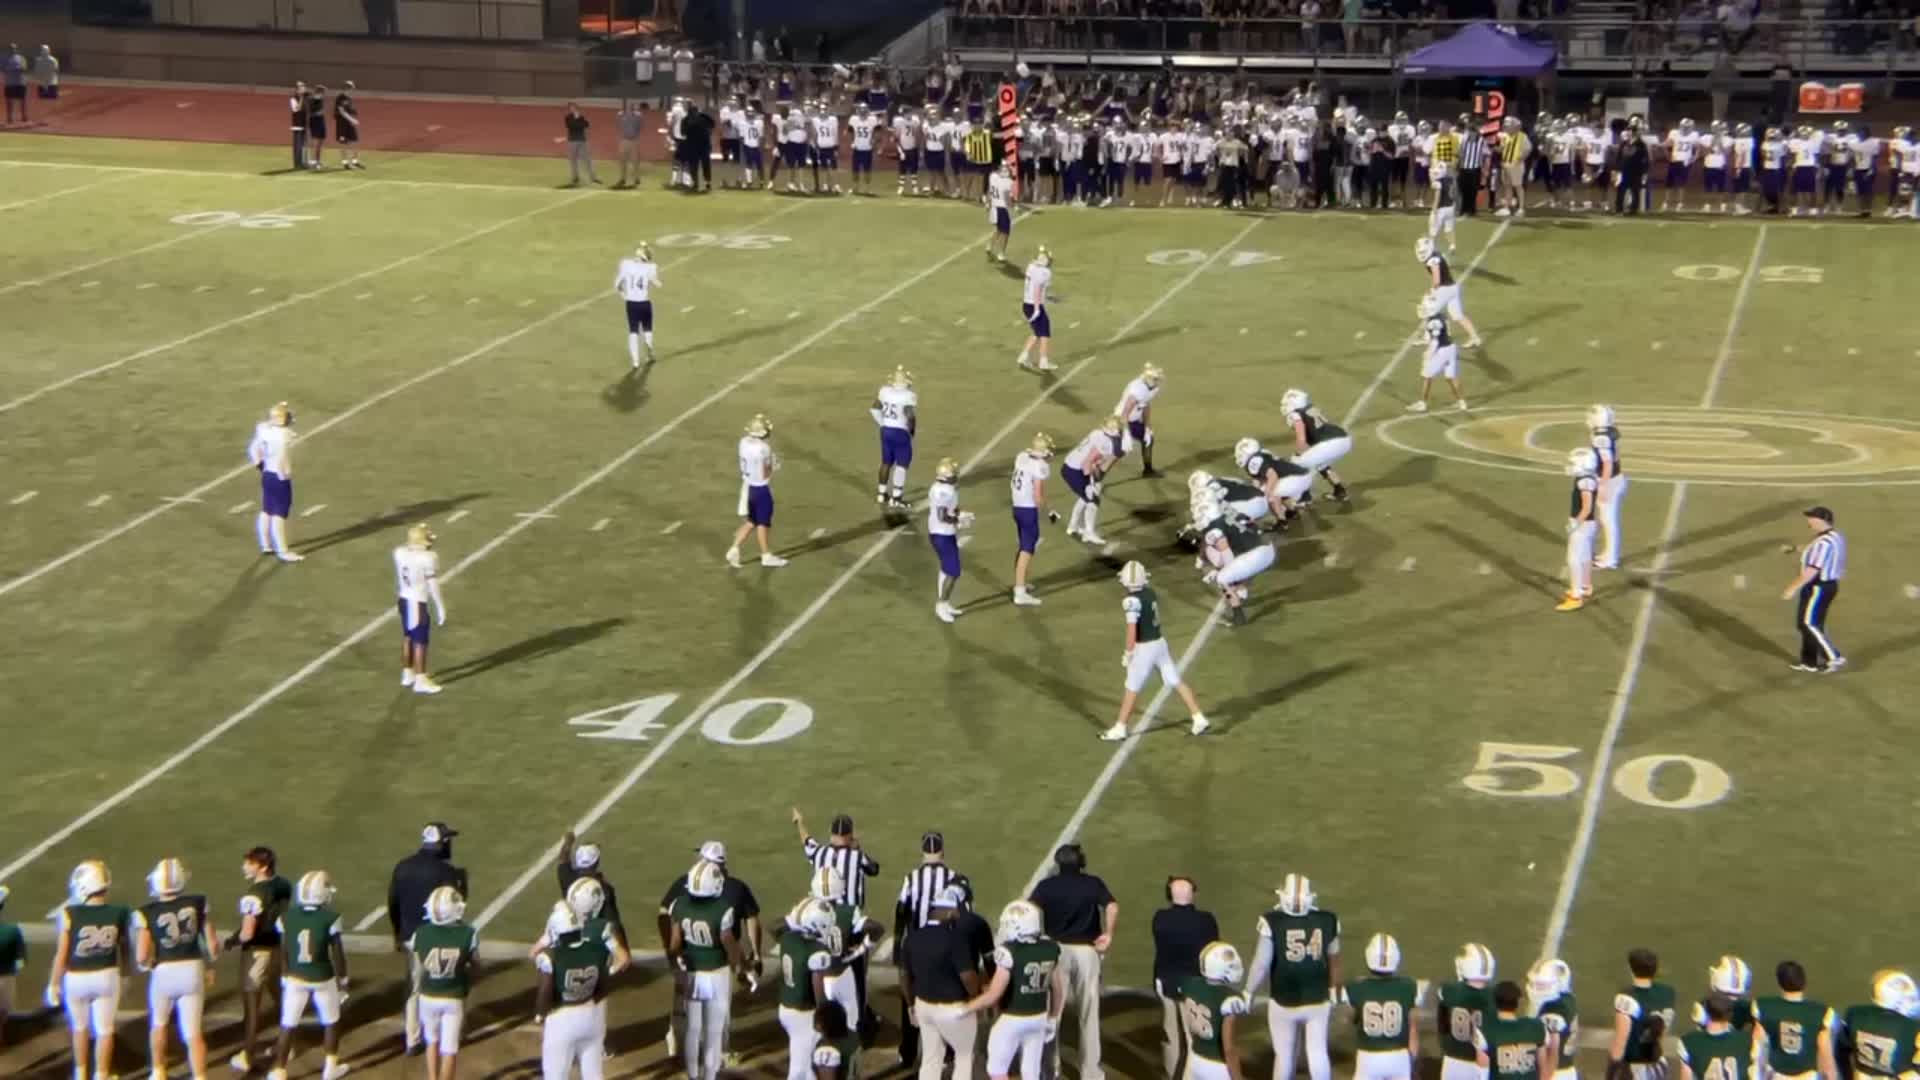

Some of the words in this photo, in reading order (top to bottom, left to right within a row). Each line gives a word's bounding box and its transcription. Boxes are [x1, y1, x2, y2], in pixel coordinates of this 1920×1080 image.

[630, 274, 644, 291] 14
[881, 401, 898, 420] 26
[567, 692, 814, 745] 40
[1462, 741, 1733, 809] 50
[156, 906, 198, 949] 33
[681, 917, 714, 947] 10
[297, 928, 313, 964] 1
[423, 947, 461, 979] 47
[1285, 928, 1323, 973] 54
[1020, 960, 1057, 993] 37
[1855, 1030, 1897, 1072] 57
